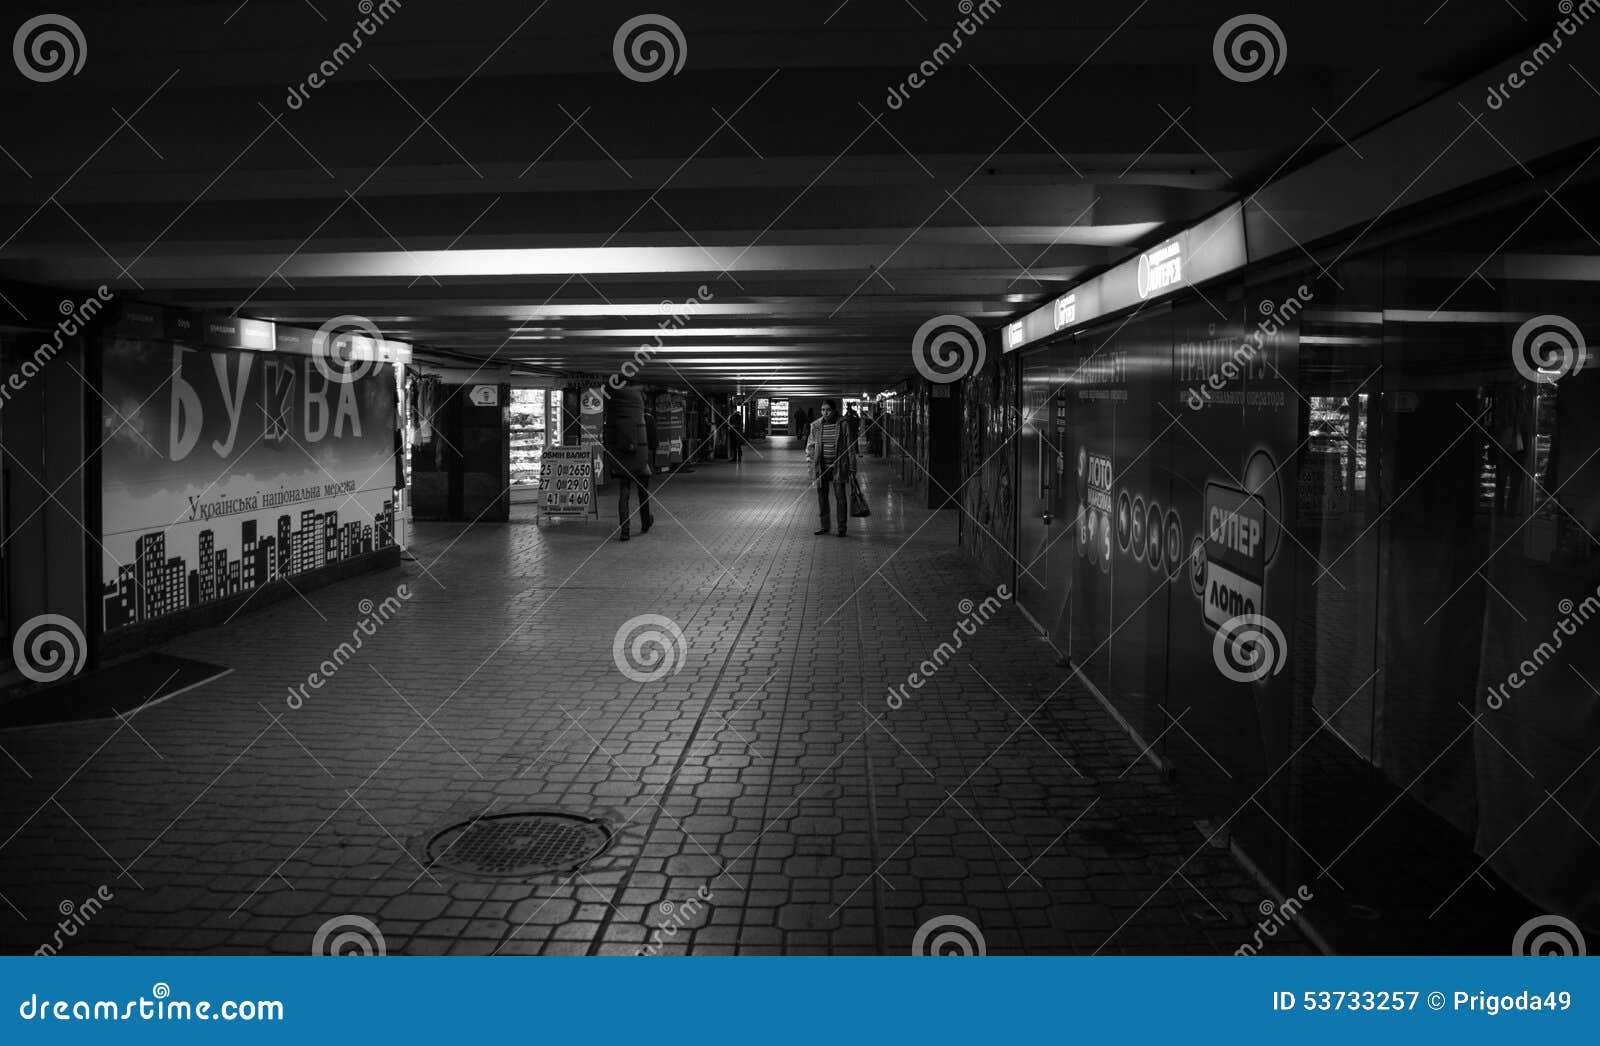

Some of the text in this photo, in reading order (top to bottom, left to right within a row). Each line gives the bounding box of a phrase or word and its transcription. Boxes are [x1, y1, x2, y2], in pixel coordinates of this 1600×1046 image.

[170, 344, 363, 462] БУКВА
[542, 451, 591, 460] ОБМІН ВАЛЮТ
[188, 493, 258, 521] Українська
[262, 485, 321, 508] національна
[1210, 505, 1260, 559] СУПЕР
